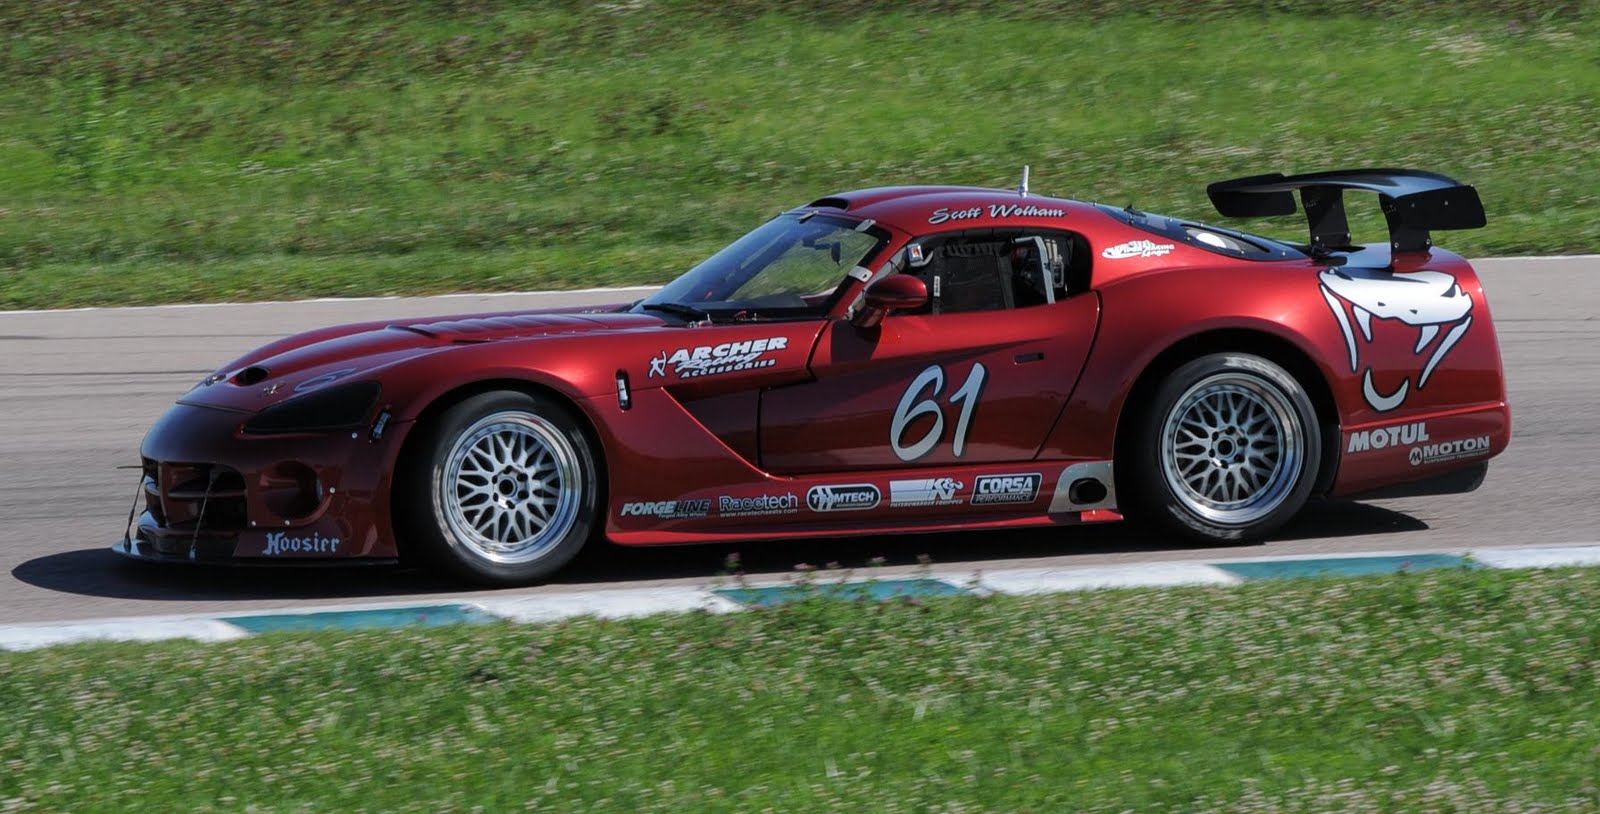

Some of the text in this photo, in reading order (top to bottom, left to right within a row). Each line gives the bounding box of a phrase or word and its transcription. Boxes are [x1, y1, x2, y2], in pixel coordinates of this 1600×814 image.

[928, 207, 983, 225] Scott
[667, 336, 789, 364] ARCHER
[681, 358, 777, 379] ACCESSORIES
[890, 362, 987, 461] 61
[1347, 422, 1430, 453] MOTUL
[1424, 436, 1490, 457] MOTON
[979, 476, 1033, 494] CORSA
[620, 499, 711, 516] FORGELINE
[719, 492, 798, 511] Racetech
[262, 531, 340, 555] Hoosier
